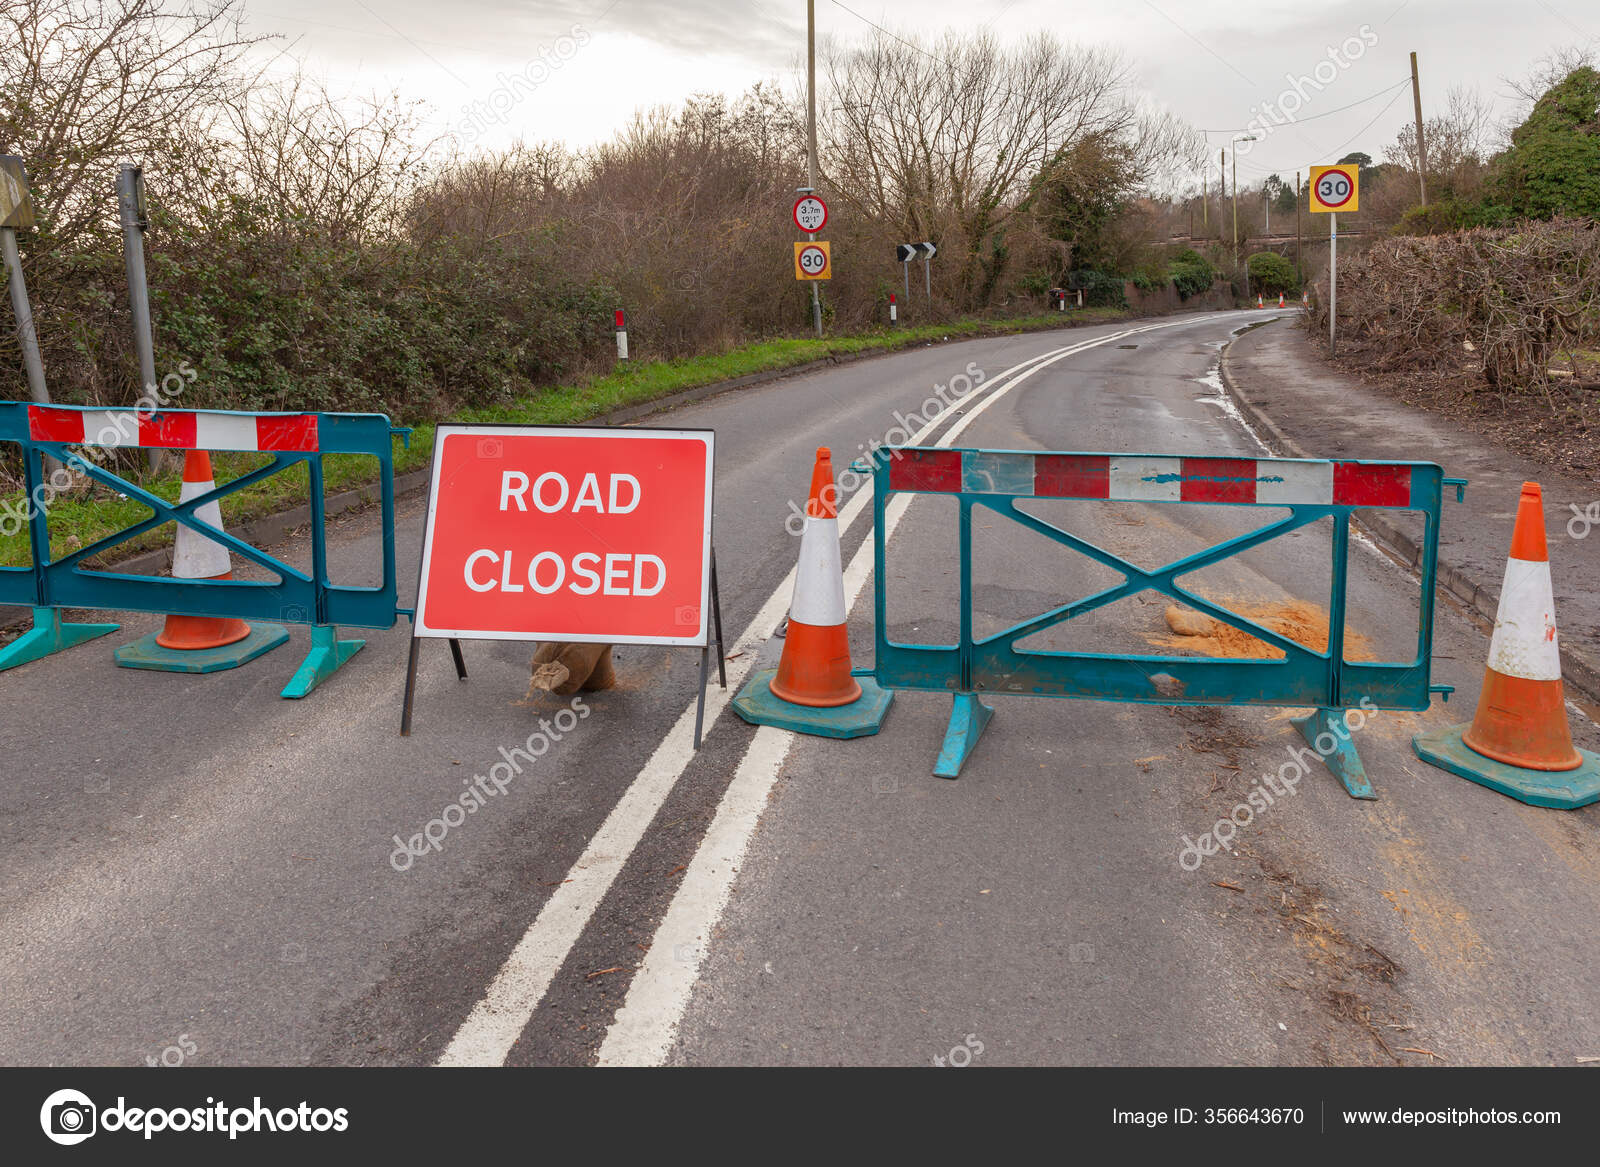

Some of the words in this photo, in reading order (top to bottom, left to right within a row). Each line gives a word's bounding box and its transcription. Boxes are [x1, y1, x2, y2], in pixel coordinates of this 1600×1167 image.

[1320, 180, 1349, 197] 30
[801, 206, 820, 214] 3.7m
[803, 255, 823, 267] 30
[499, 470, 642, 515] ROAD
[463, 548, 667, 597] CLOSED
